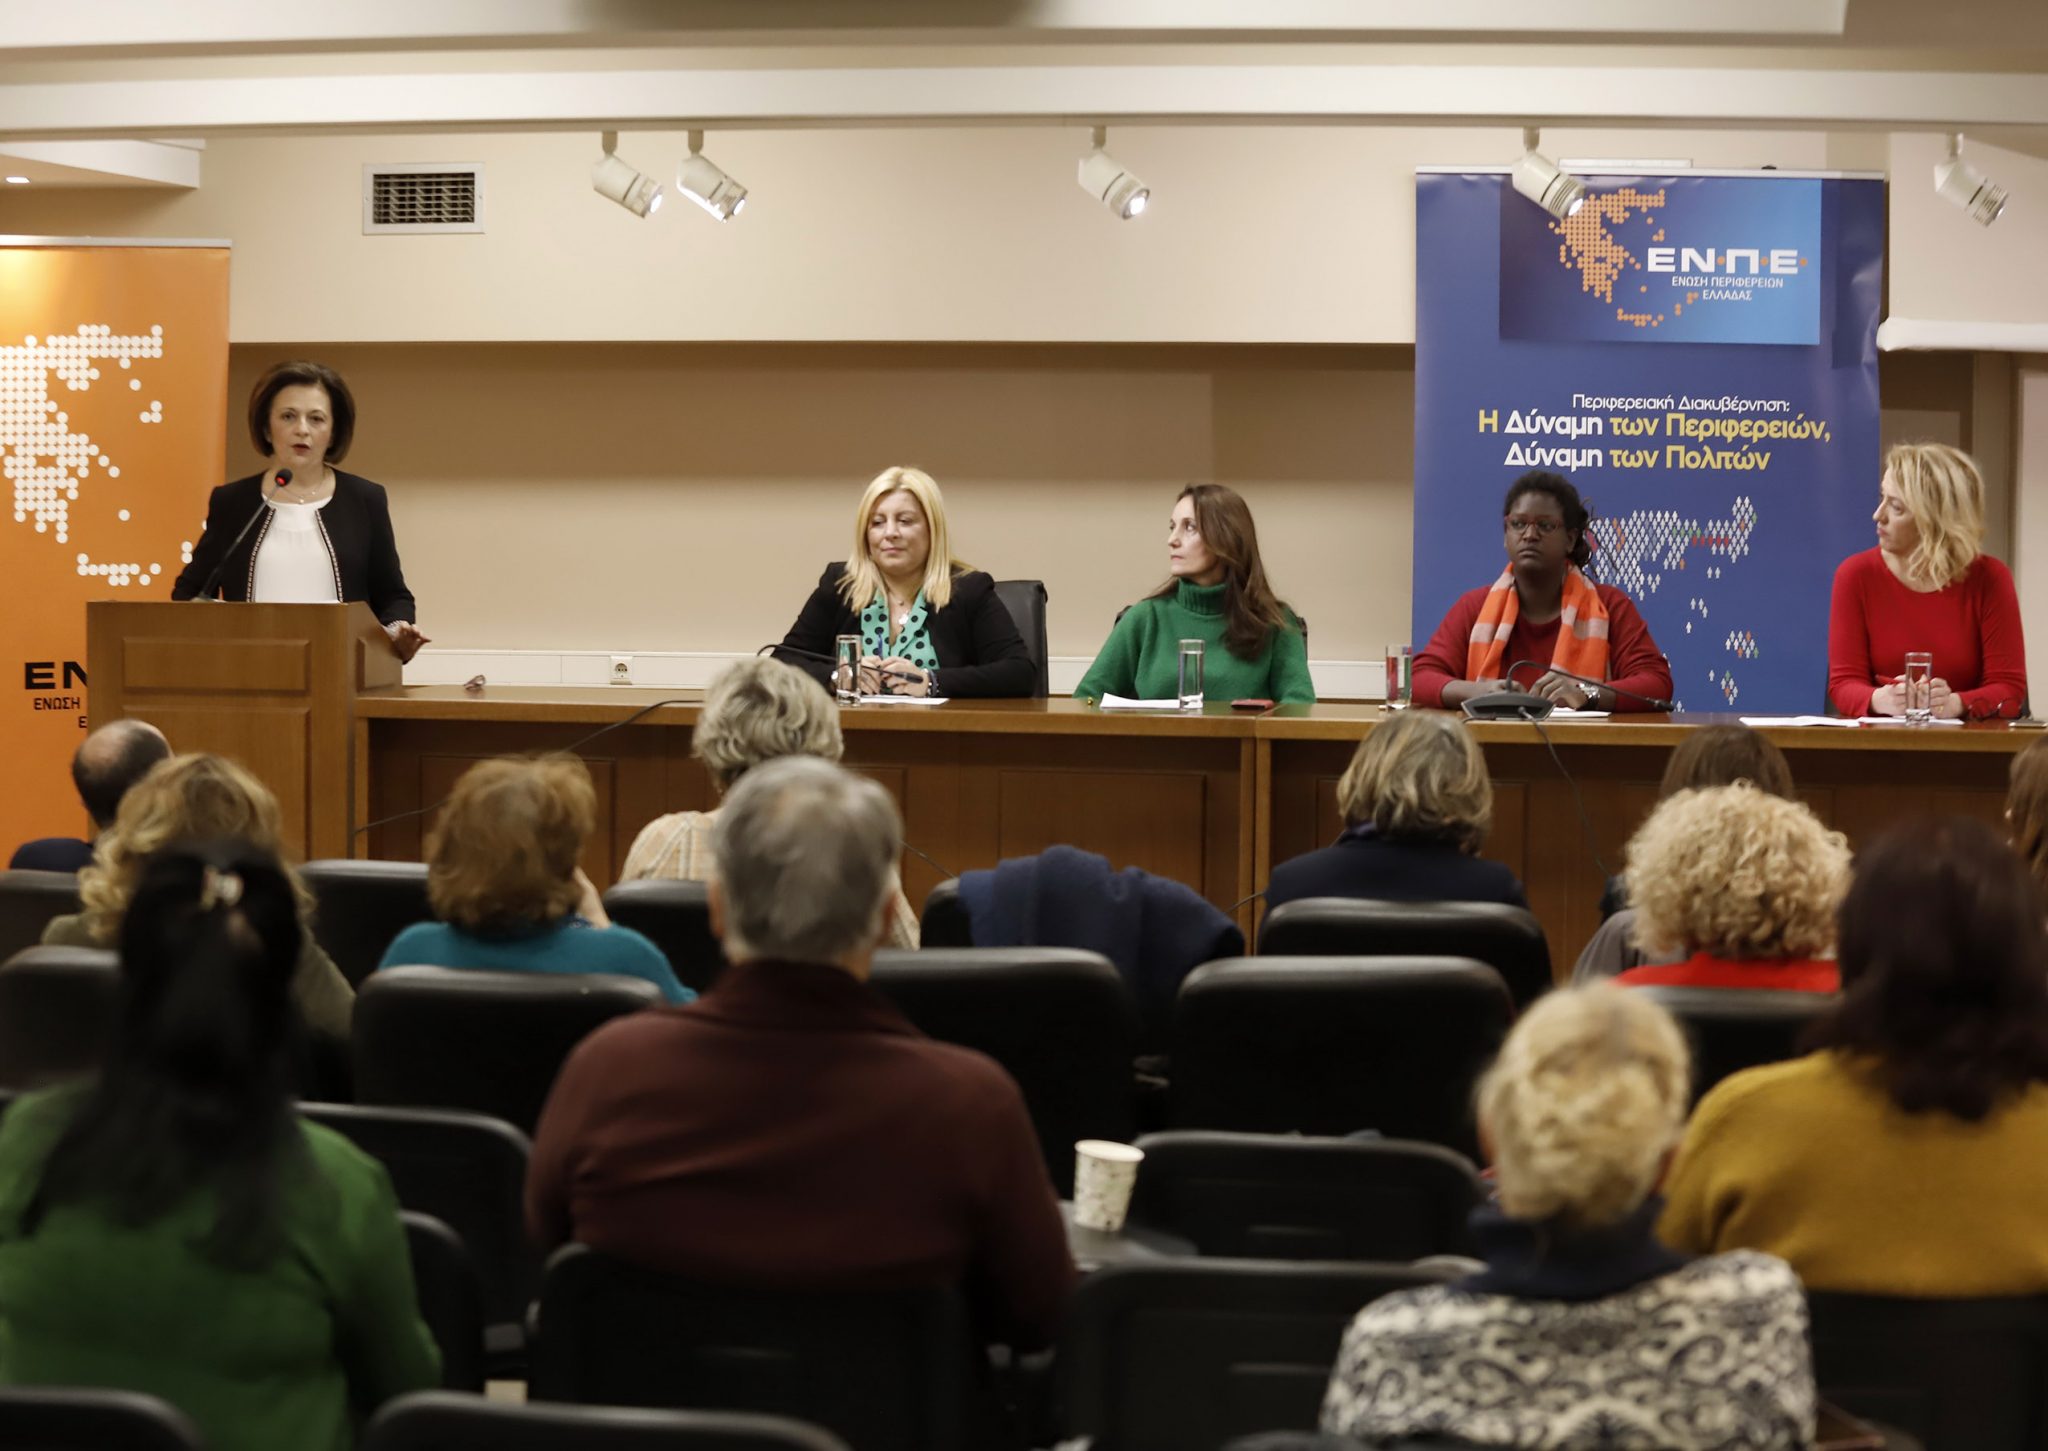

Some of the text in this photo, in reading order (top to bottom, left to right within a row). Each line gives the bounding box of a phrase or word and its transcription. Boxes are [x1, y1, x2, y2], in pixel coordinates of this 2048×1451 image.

[1671, 275, 1784, 289] ΕΝΩΣΗ ΠΕΡΙΦΕΡΕΙΩΝ
[1702, 289, 1753, 301] ΕΛΛΑΔΑΣ
[1572, 393, 1791, 414] Περιφερειακή Διακυβέρνηση:
[1478, 408, 1831, 444] Η Δύναμη των Περιφερειών,
[1503, 440, 1771, 473] Δύναμη των Πολιτών
[33, 697, 81, 710] ΕΝΩΣΗ
